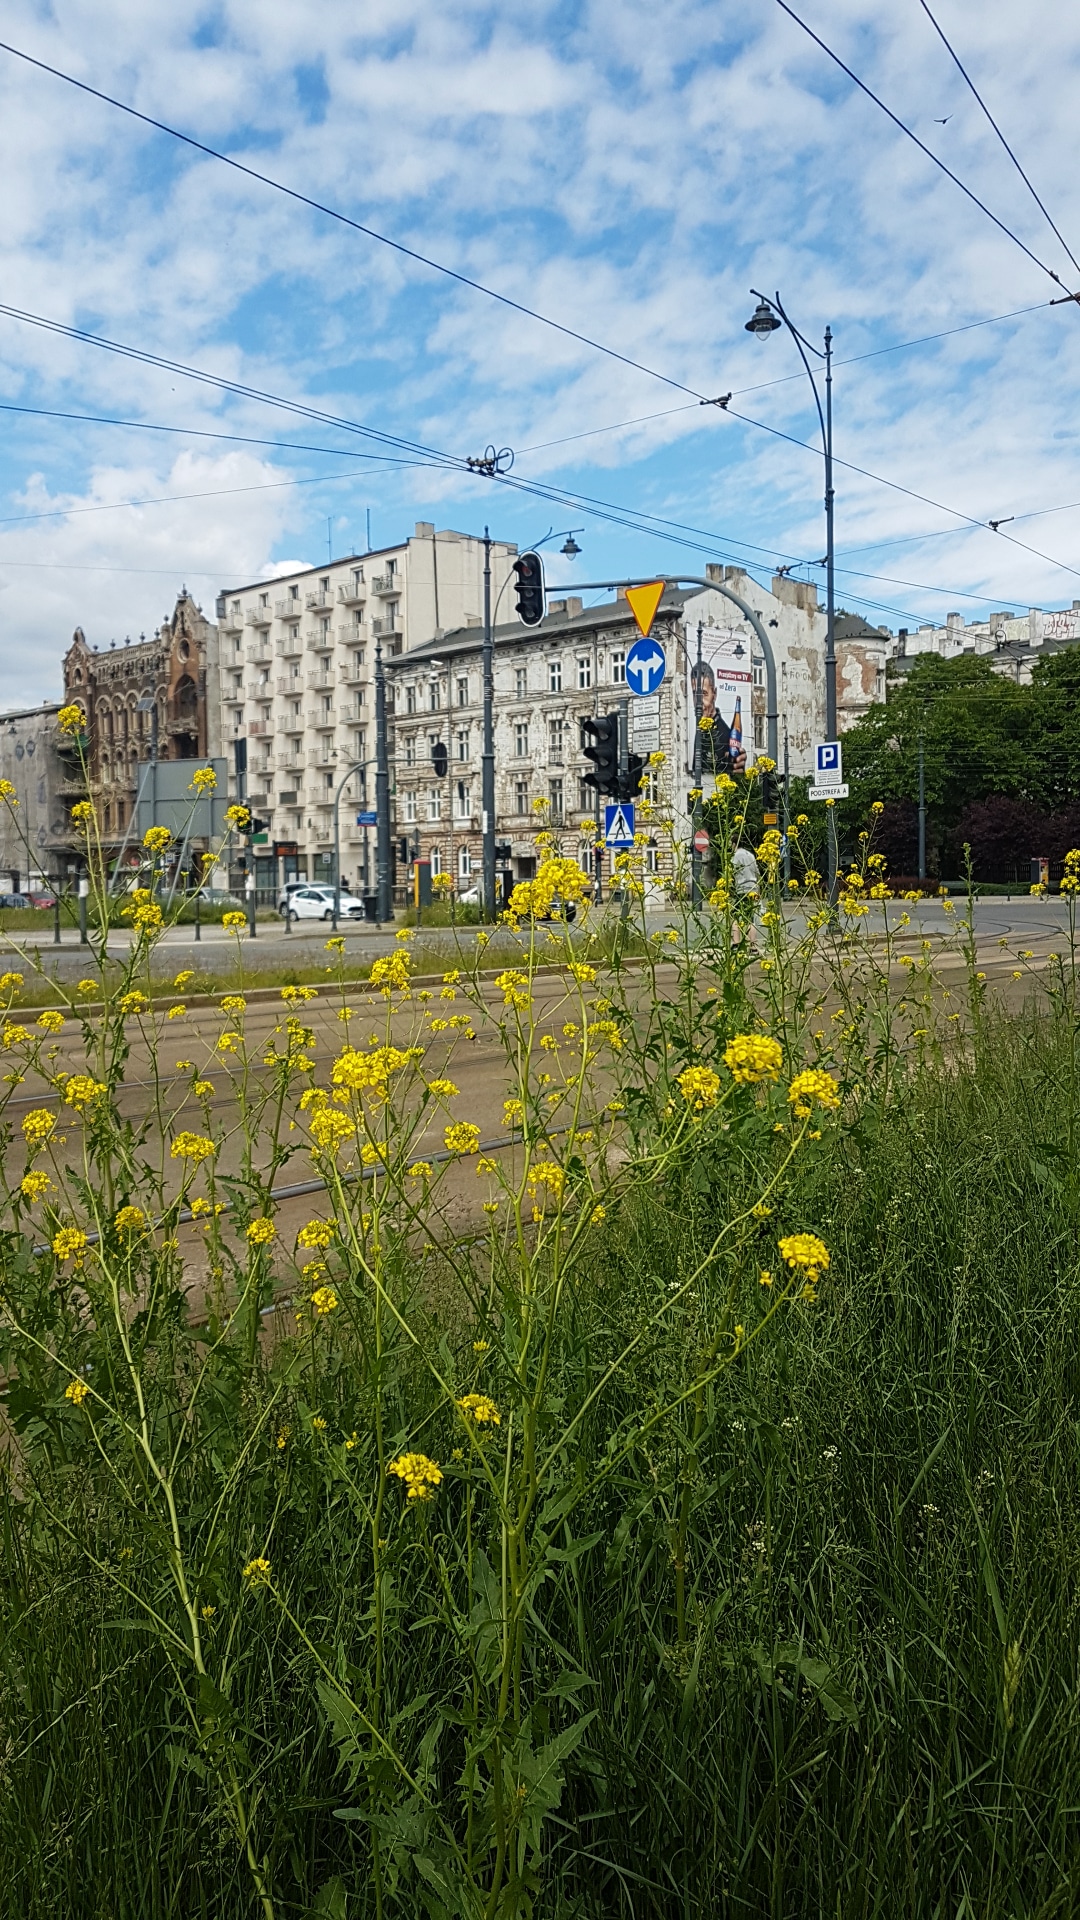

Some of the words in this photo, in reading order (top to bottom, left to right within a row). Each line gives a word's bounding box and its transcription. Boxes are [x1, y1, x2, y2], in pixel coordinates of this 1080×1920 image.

[724, 683, 737, 692] Zera
[821, 747, 835, 768] P
[811, 789, 841, 797] PODSTREFA
